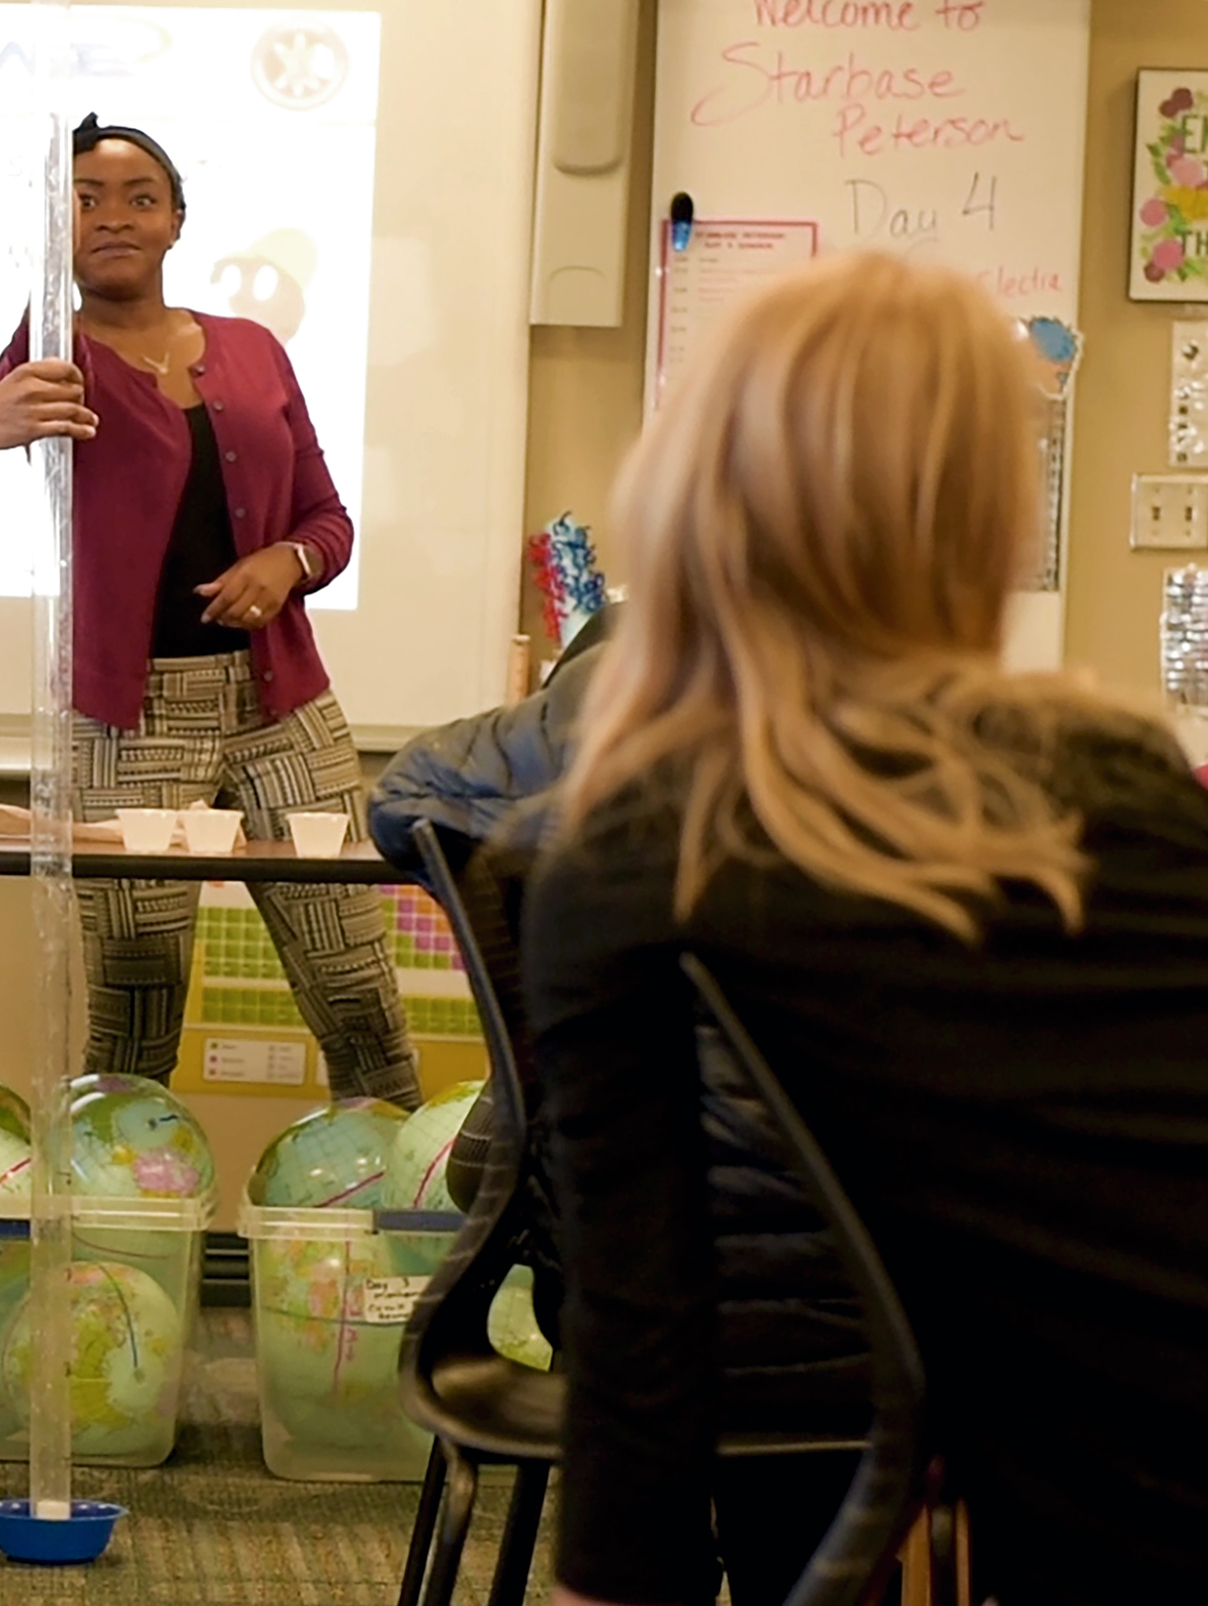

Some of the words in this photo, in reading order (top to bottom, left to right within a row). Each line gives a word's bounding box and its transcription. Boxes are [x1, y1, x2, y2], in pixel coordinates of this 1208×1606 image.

[755, 0, 920, 31] Welcome
[935, 0, 985, 31] to
[690, 41, 968, 127] Starbase
[833, 103, 1025, 157] Peterson
[844, 177, 940, 254] Day
[960, 171, 998, 231] 4
